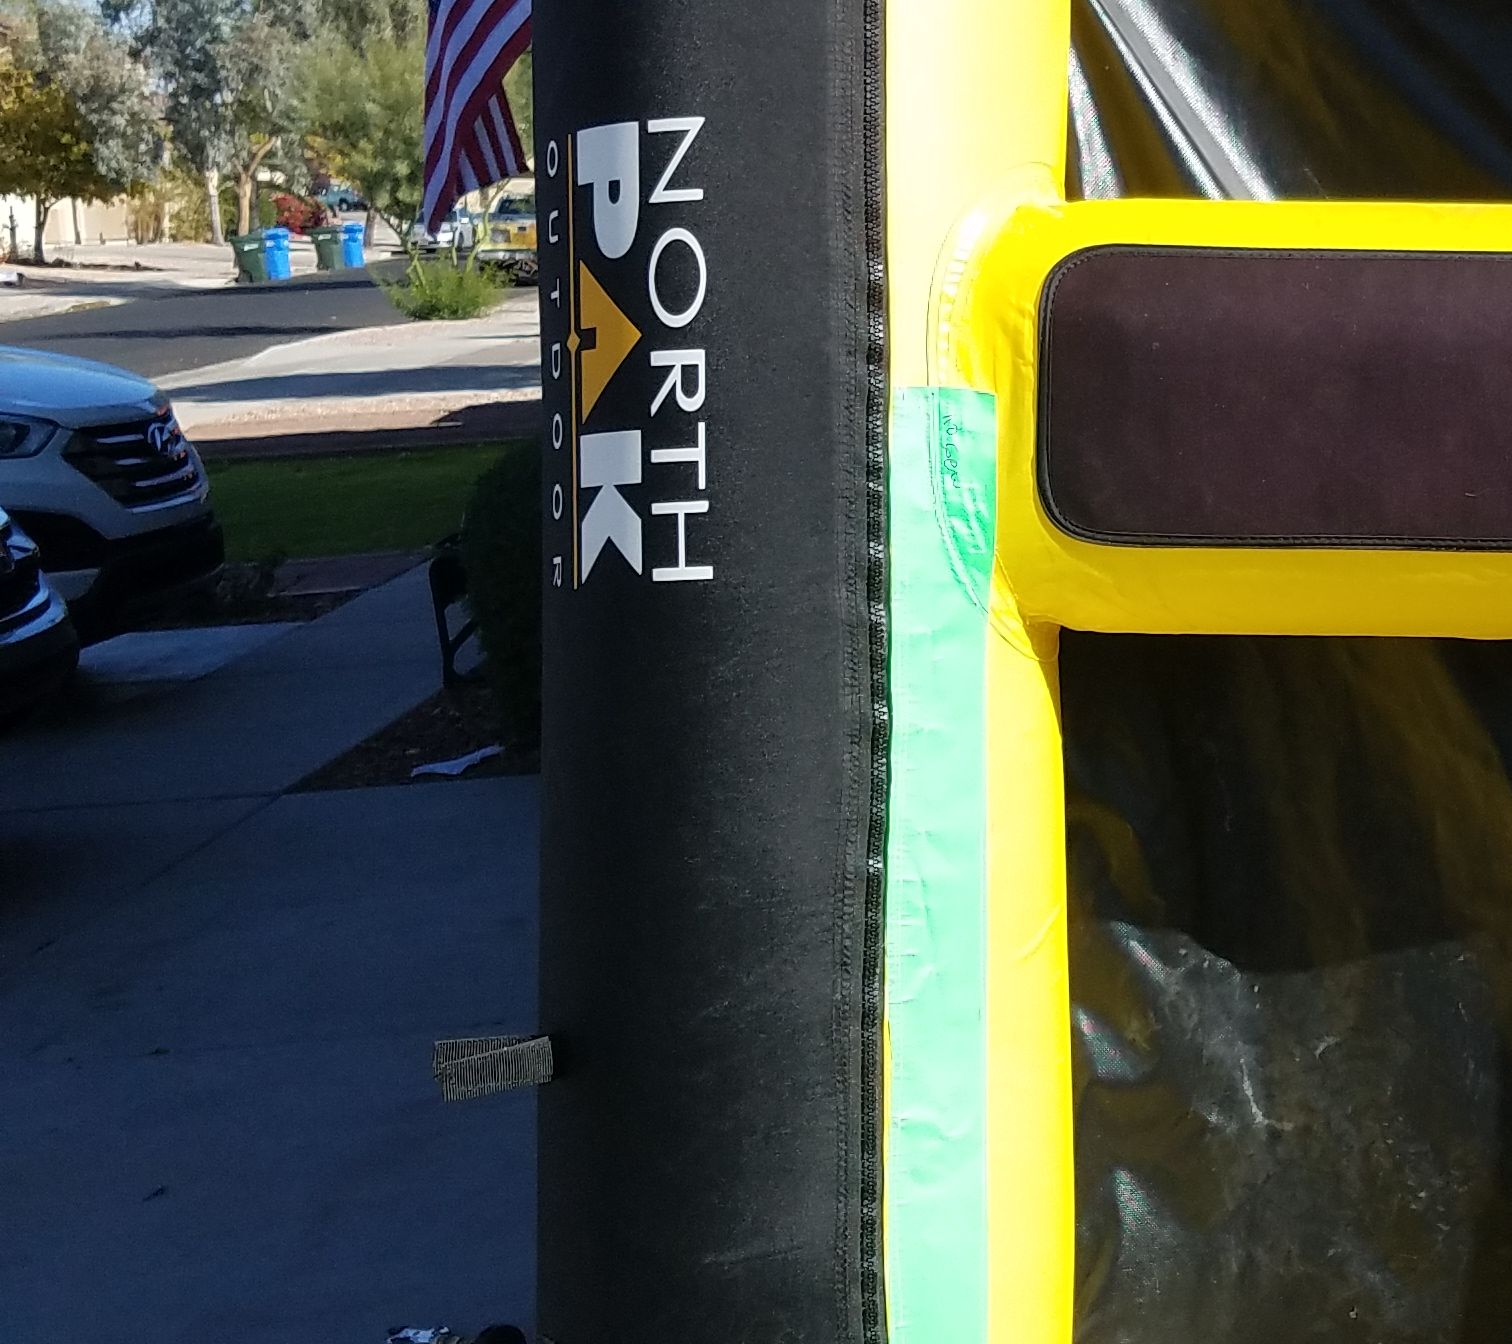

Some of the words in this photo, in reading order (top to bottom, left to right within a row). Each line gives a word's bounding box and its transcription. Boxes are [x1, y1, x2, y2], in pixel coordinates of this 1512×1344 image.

[546, 140, 564, 587] OUTDOOR
[576, 121, 643, 584] PAK
[647, 116, 714, 581] NORTH
